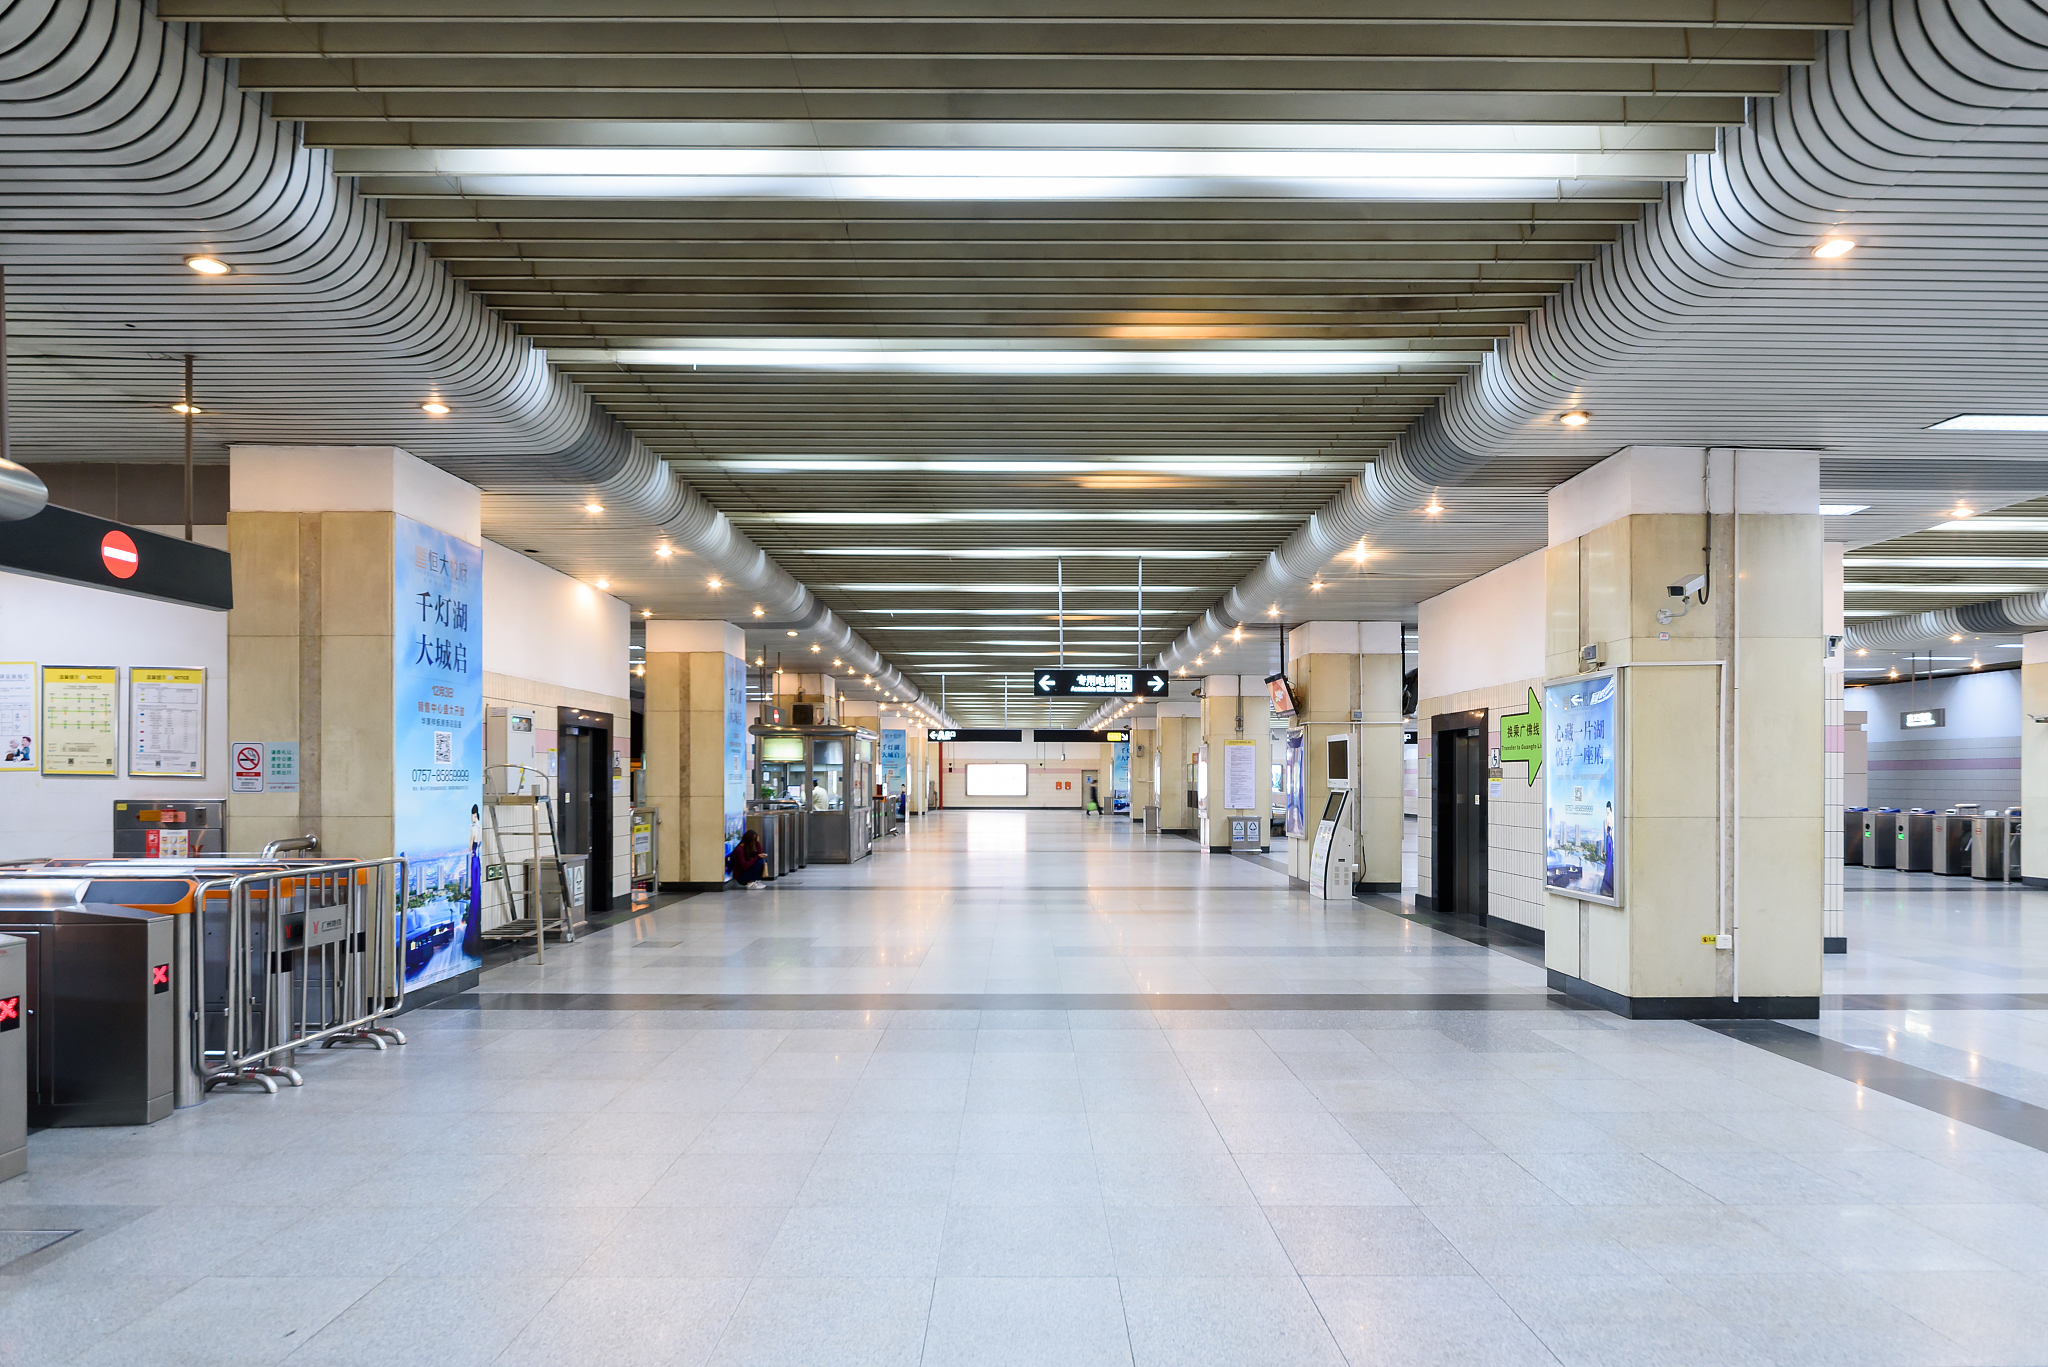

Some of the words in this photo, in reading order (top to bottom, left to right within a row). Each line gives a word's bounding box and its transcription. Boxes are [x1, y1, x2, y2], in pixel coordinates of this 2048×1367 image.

[416, 592, 468, 632] 千灯湖
[416, 634, 467, 674] 大城启
[1076, 674, 1115, 687] 专用电梯
[1507, 722, 1540, 738] 换乘广佛线
[1555, 720, 1604, 742] 心藏一片湖
[1555, 744, 1604, 766] 悦享一座府
[412, 769, 469, 782] 0757-85859999
